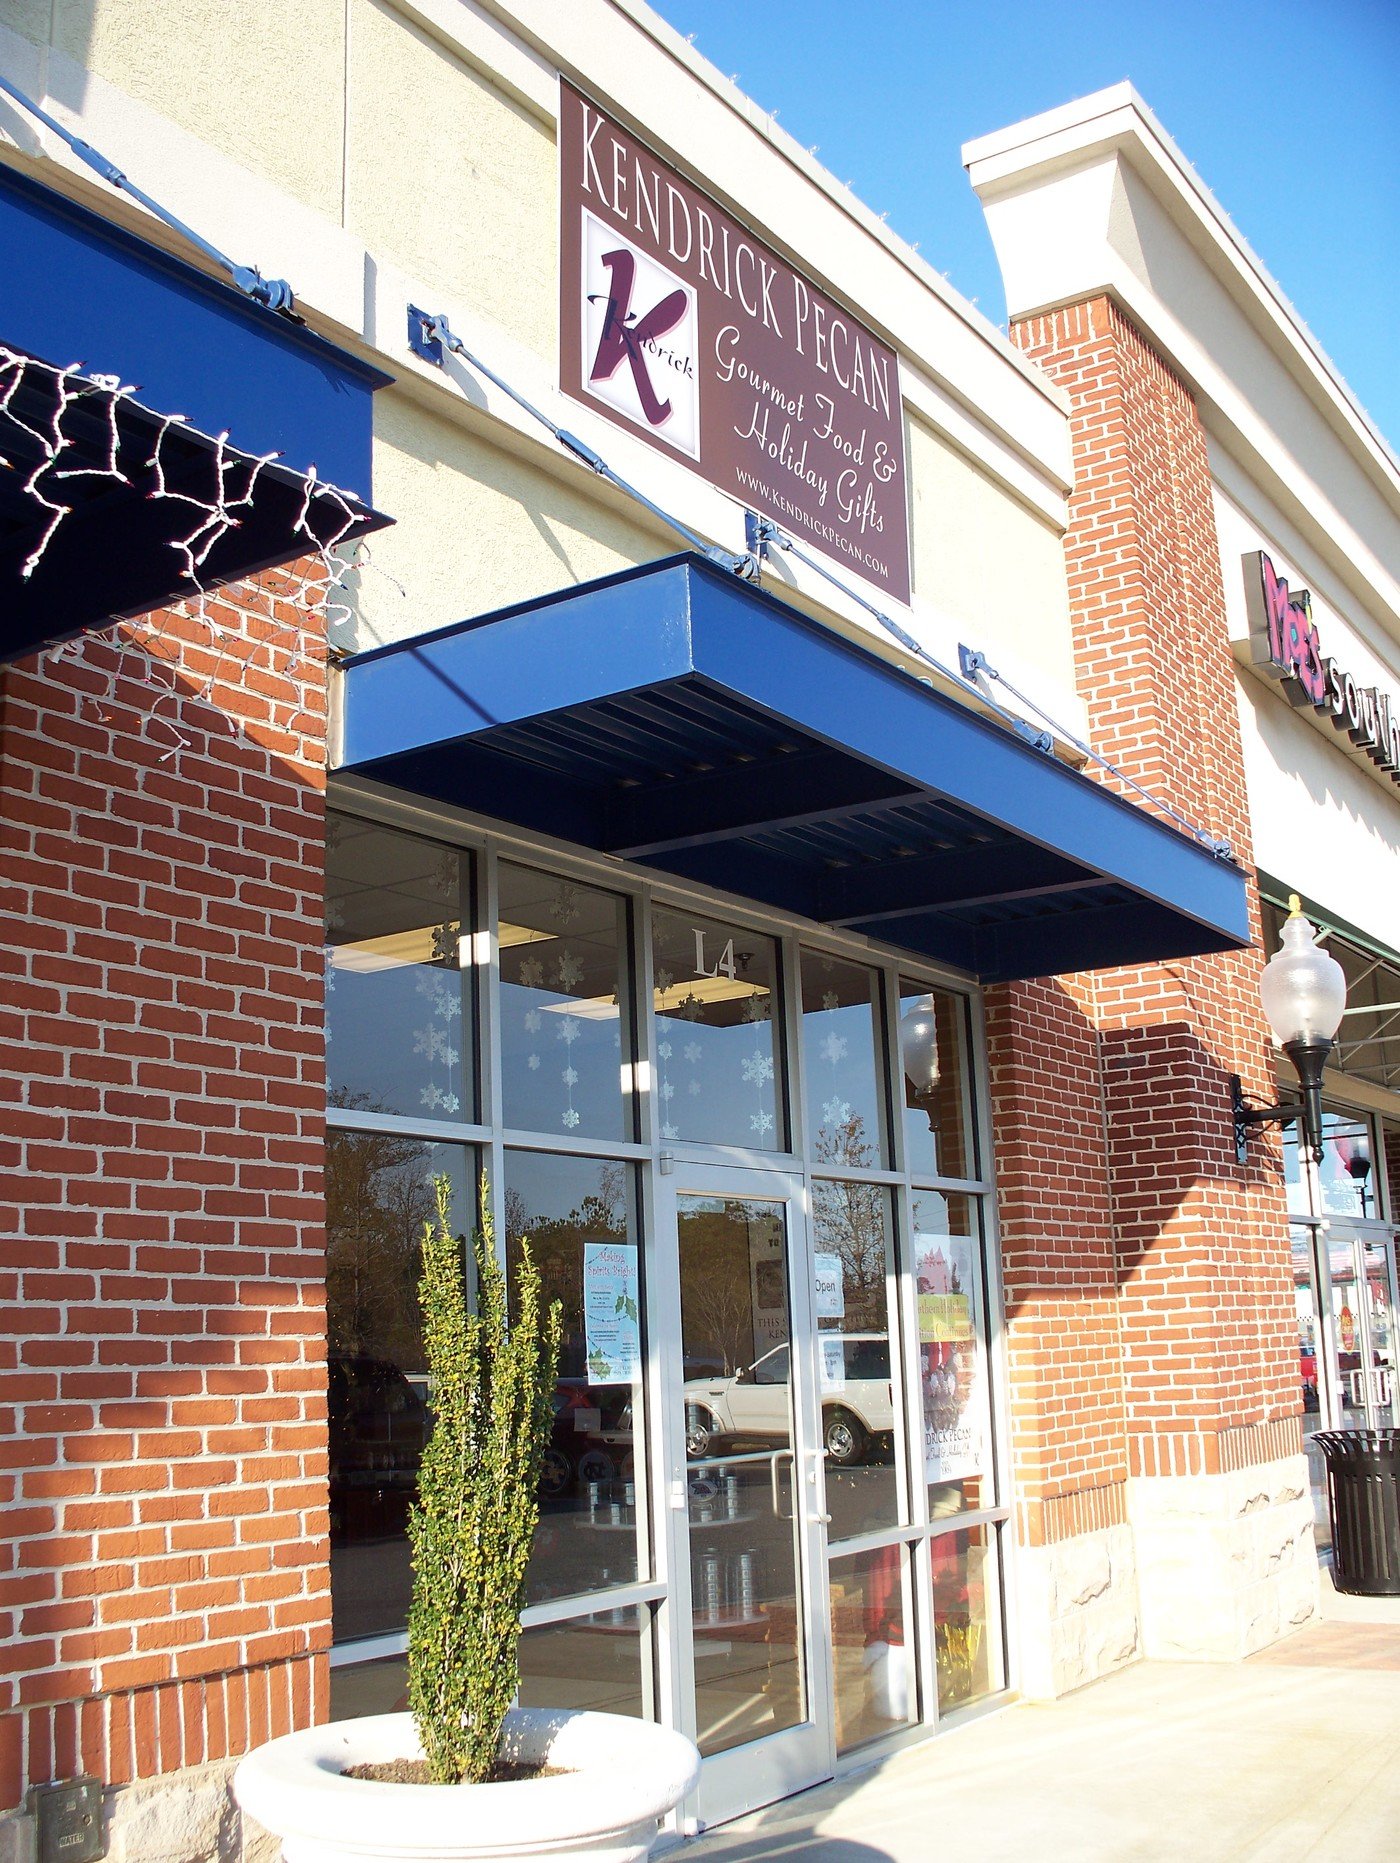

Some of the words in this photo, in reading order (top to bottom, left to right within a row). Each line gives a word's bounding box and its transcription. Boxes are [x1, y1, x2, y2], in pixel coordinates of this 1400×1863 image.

[579, 100, 783, 339] KENDRICK
[792, 274, 890, 421] PECAN
[587, 295, 693, 380] Kendrick
[715, 325, 804, 422] Gourmet
[813, 393, 867, 466] Food
[872, 441, 897, 483] &
[734, 401, 828, 506] Holiday
[836, 469, 884, 534] Gifts
[736, 466, 889, 579] WWW.KENDRICKPECAN.COM
[691, 928, 737, 982] L4
[757, 1317, 780, 1328] THIS
[815, 1279, 836, 1294] Open
